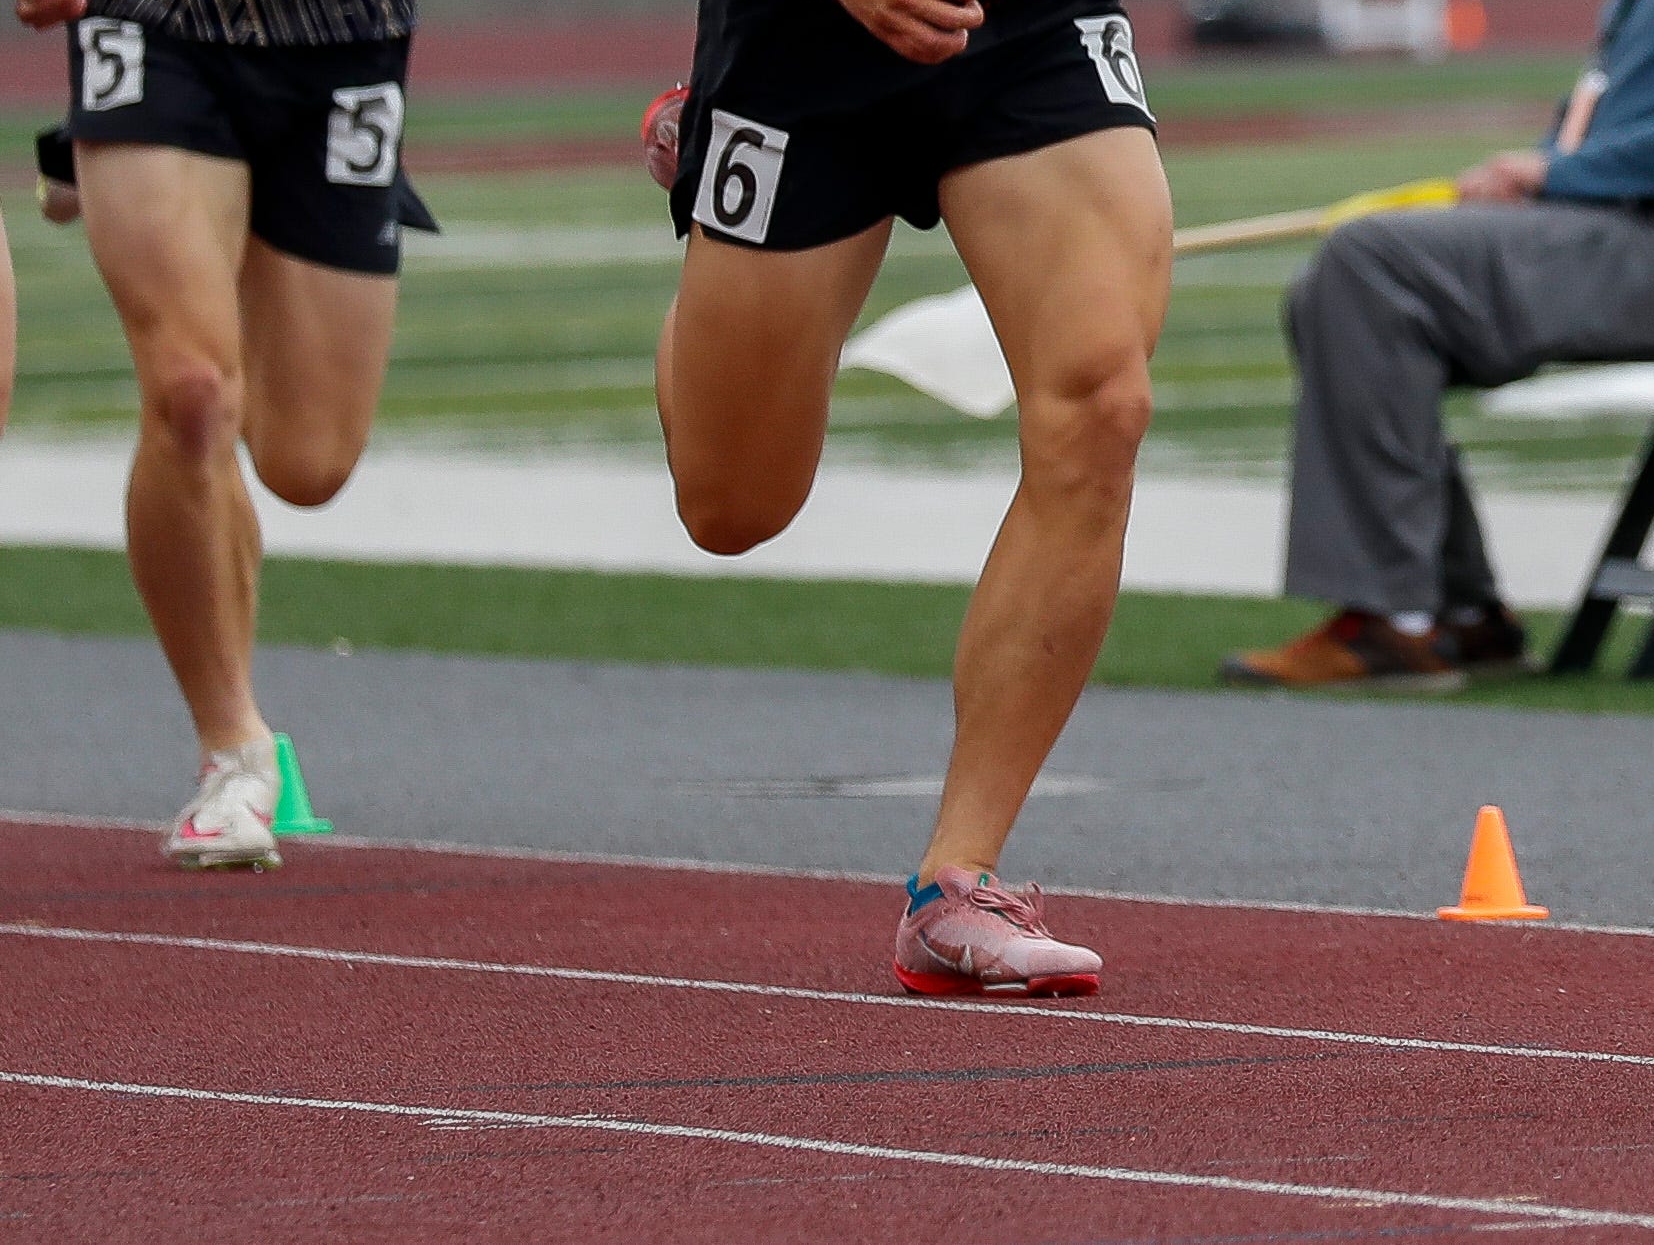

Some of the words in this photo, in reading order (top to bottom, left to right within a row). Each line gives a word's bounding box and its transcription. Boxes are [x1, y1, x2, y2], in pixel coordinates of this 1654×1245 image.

[92, 27, 126, 100] 5
[1102, 21, 1145, 107] 6
[344, 96, 386, 174] 5
[714, 126, 766, 228] 6
